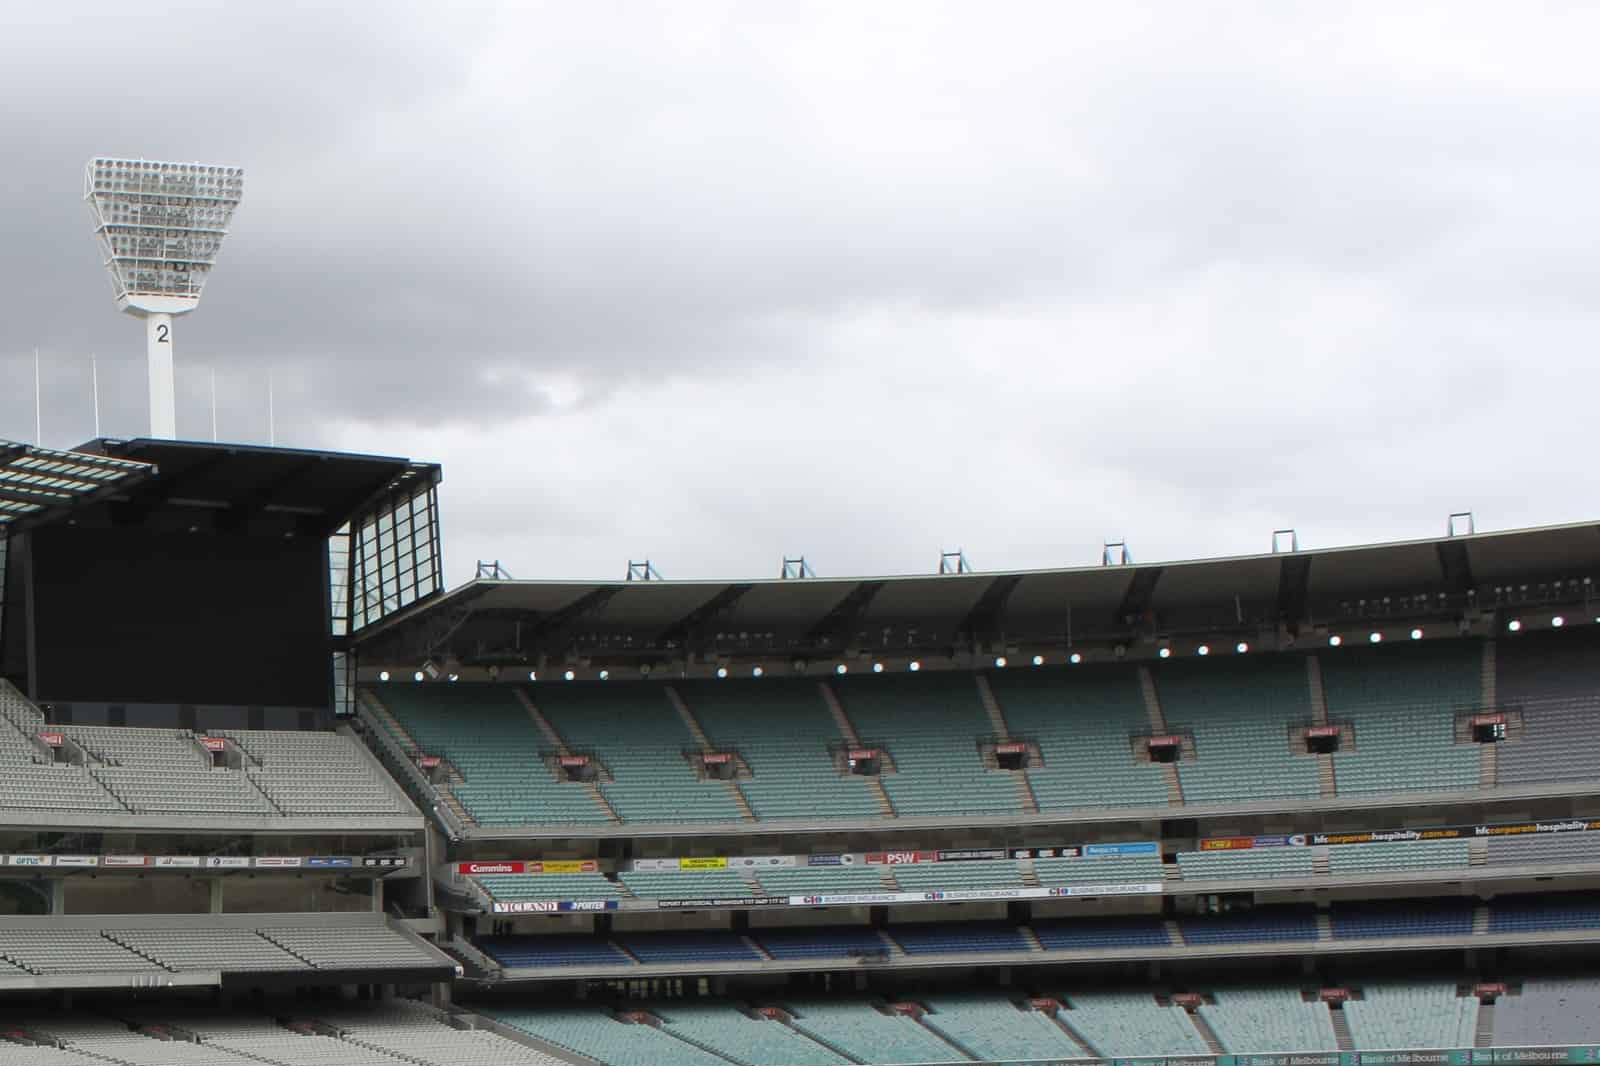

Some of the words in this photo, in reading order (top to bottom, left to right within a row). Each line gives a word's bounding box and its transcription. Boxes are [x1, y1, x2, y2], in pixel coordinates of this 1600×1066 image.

[156, 324, 169, 343] 2
[887, 853, 914, 864] PSW
[470, 863, 513, 873] Cummins
[1252, 1056, 1275, 1066] Bank
[1289, 1055, 1339, 1065] Melbourne
[1361, 1055, 1384, 1064] Bank
[1397, 1053, 1449, 1063] Melbourne
